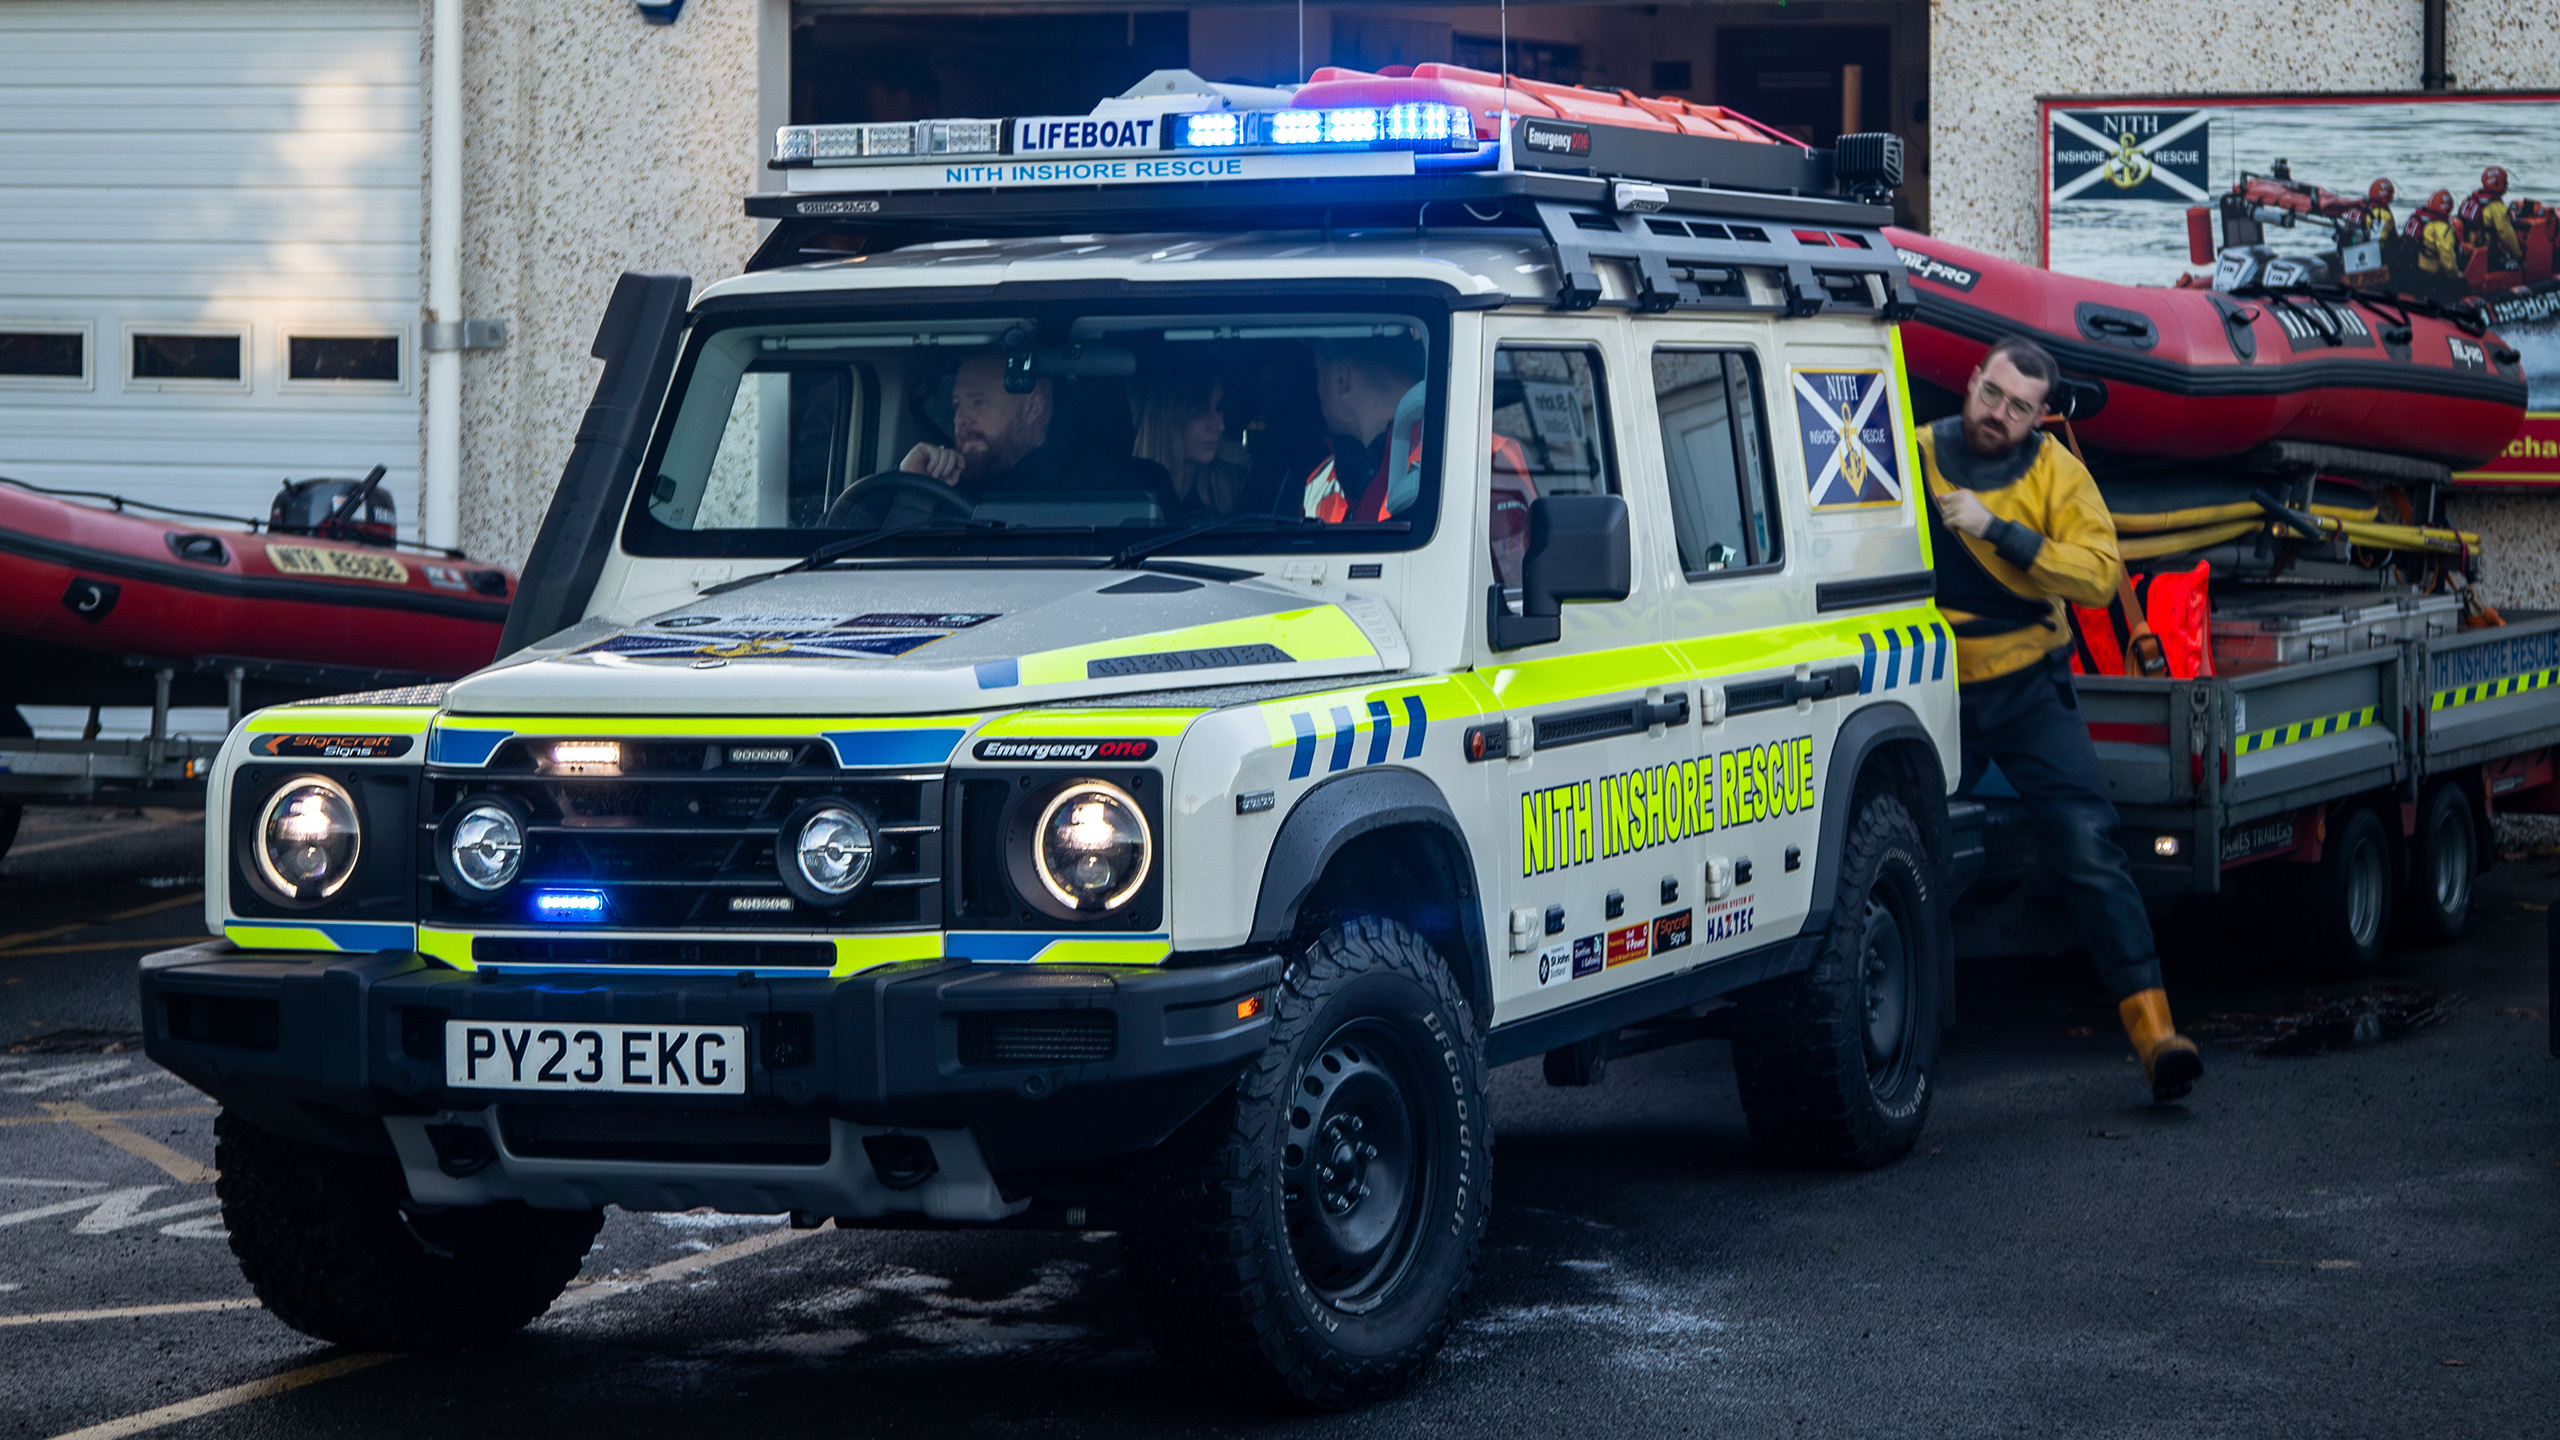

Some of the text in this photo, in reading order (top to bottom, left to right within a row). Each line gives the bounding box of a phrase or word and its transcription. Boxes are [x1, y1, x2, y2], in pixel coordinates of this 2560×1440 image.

[1023, 120, 1154, 150] LIFEBOAT
[2103, 115, 2158, 134] NITH
[1529, 127, 1572, 152] Emergency
[2058, 151, 2200, 164] INSHORE RESCUE
[946, 159, 1242, 183] NITH INSHORE RESCUE
[2494, 289, 2560, 324] INSHOR
[1825, 375, 1859, 400] NITH
[1809, 428, 1886, 445] INSHORE RESCUE
[1096, 646, 1283, 674] GRENADIER
[2453, 639, 2508, 685] INSHORE
[2511, 628, 2560, 674] RESCUE
[292, 735, 392, 749] Signcraft
[324, 746, 373, 758] Signs
[983, 742, 1098, 760] Emergency
[1521, 736, 1814, 878] NITH INSHORE RESCUE
[1706, 906, 1754, 944] HAZTEC
[466, 1027, 726, 1086] PY23 EKG
[1423, 1011, 1472, 1237] BFGoodrich
